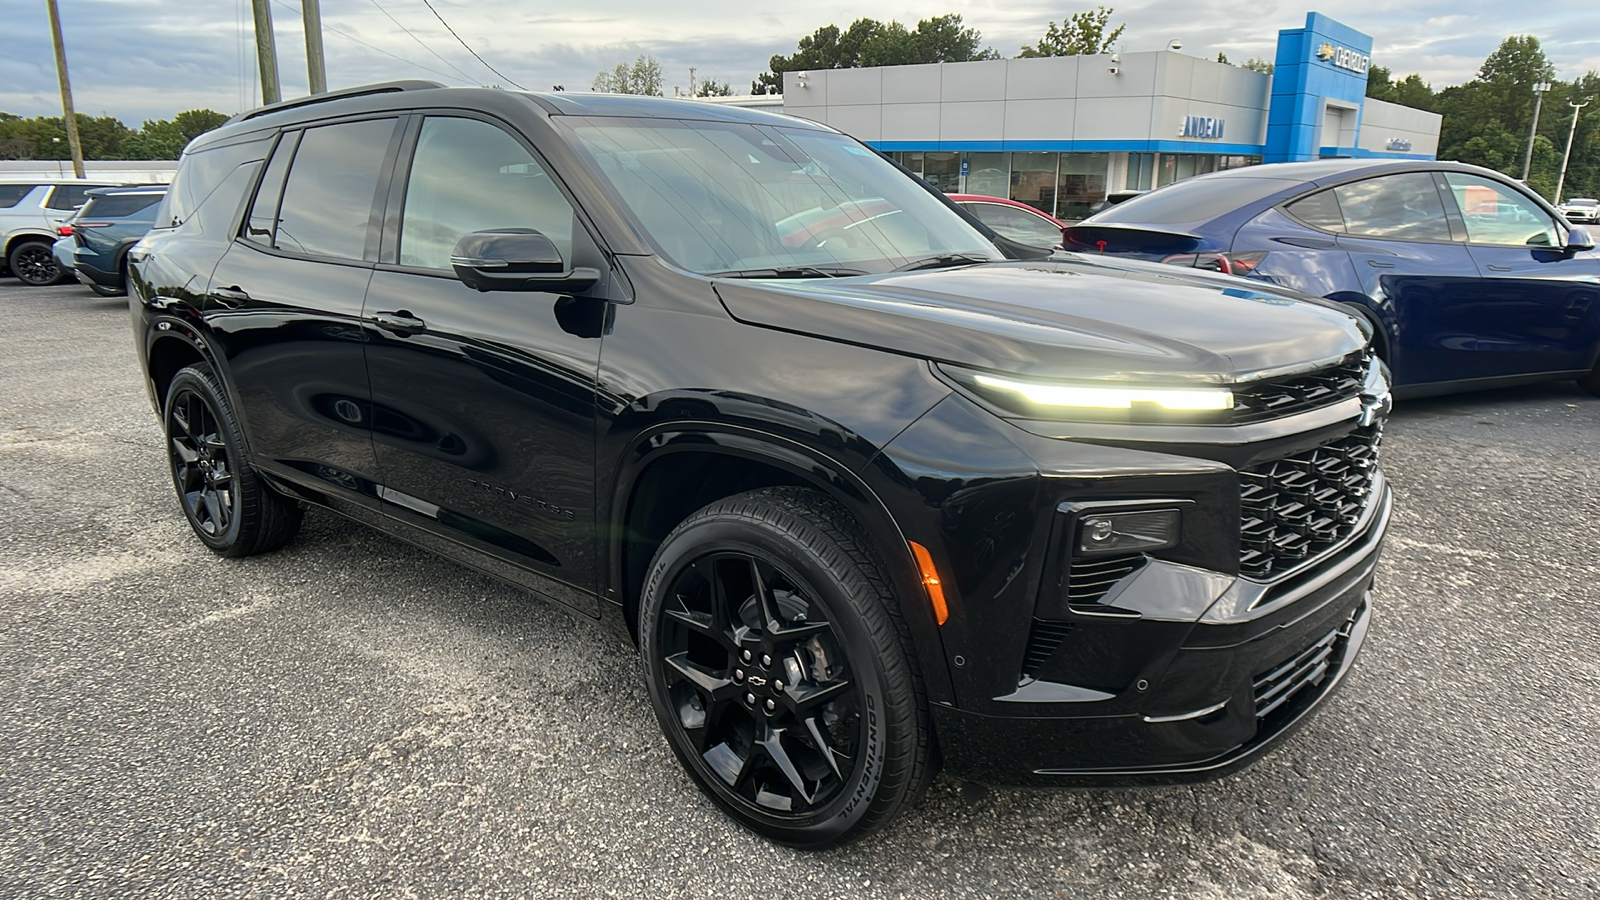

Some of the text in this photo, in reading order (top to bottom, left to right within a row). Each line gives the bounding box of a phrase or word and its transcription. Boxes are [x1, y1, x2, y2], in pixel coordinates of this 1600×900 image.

[1180, 115, 1226, 139] ANDEAN
[467, 478, 576, 521] TRAVERSE
[838, 693, 878, 820] CONTINENTAL
